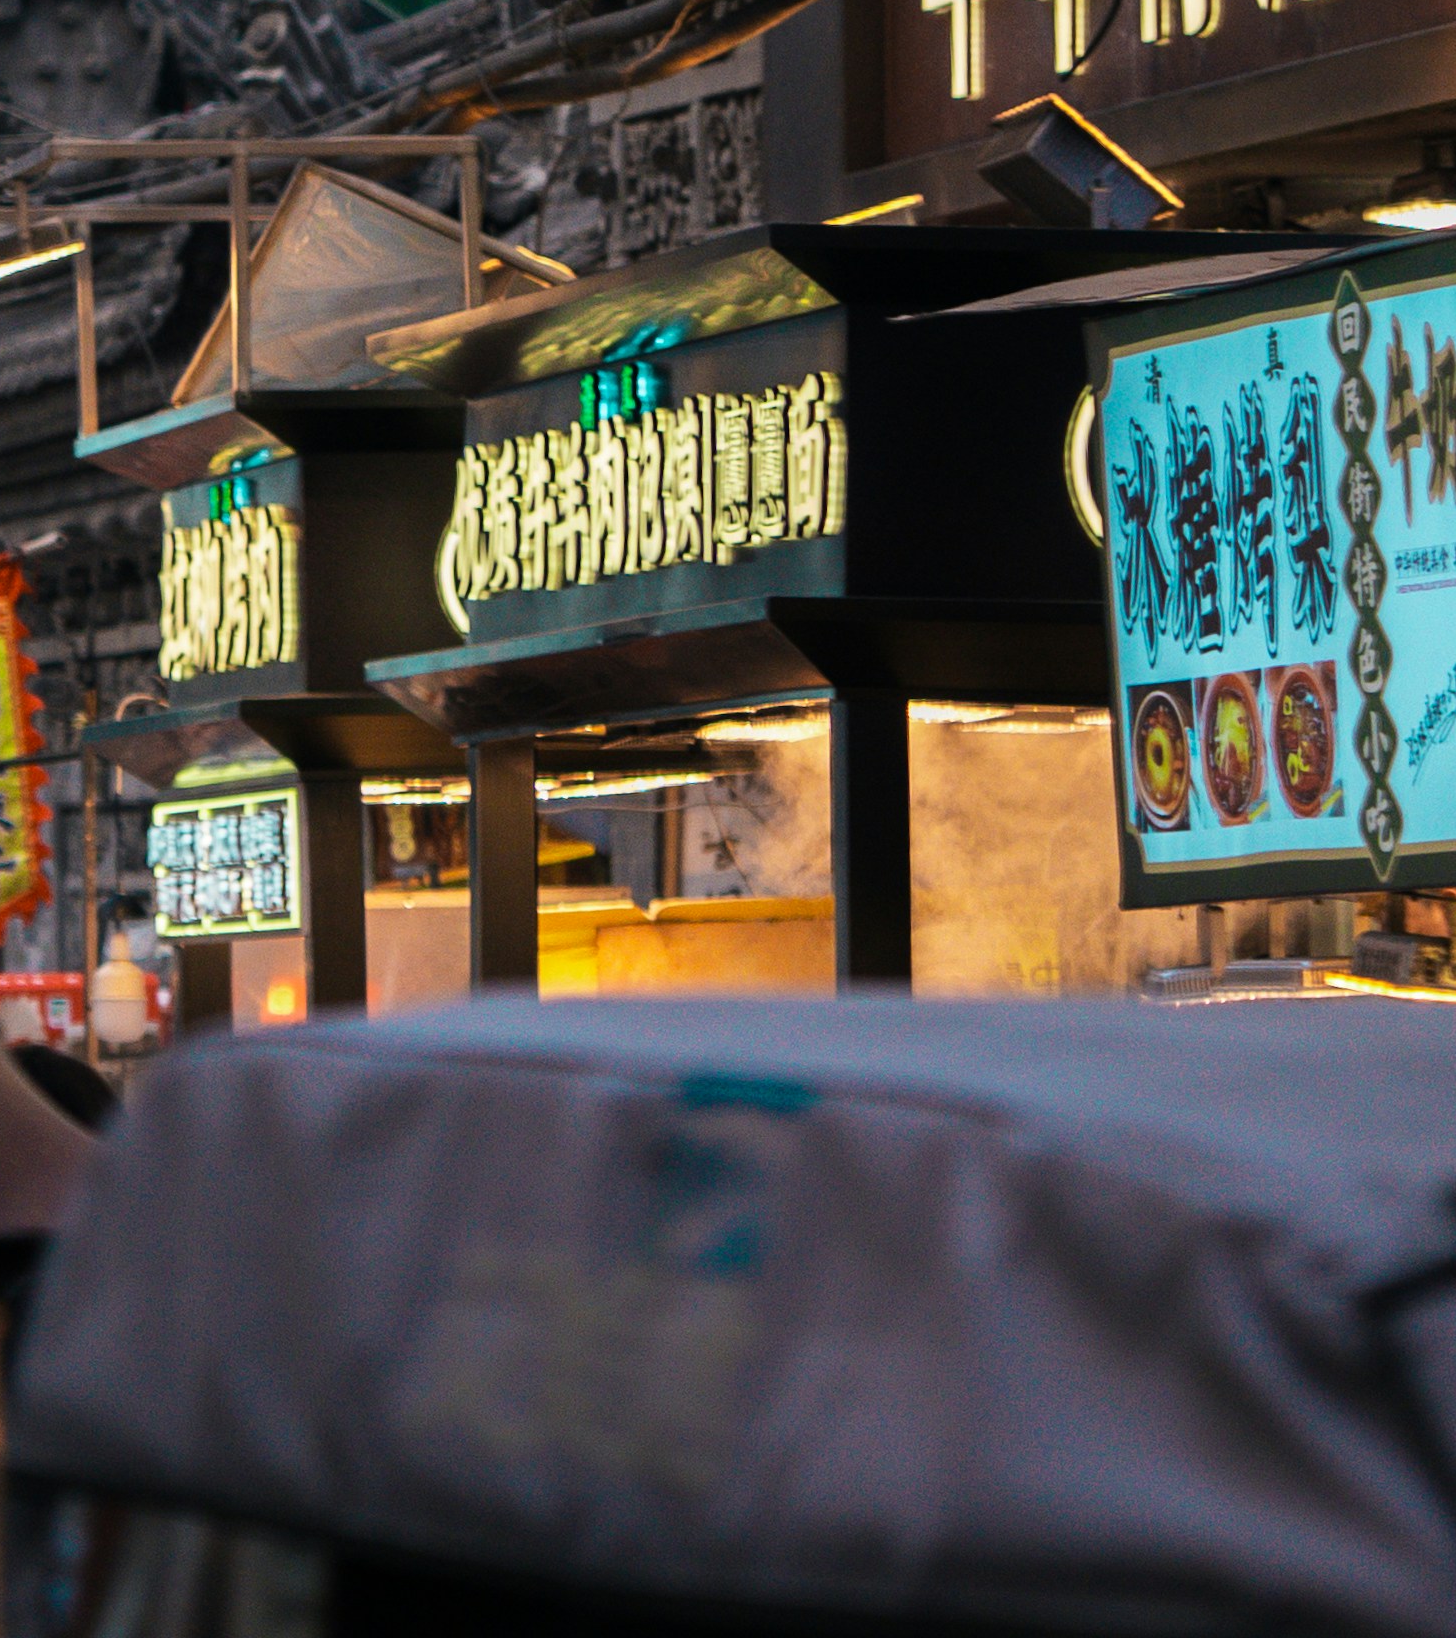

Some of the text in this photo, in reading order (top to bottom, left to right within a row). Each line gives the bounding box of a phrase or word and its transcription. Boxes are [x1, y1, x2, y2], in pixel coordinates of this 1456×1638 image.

[1336, 301, 1396, 854] 回民街特色小吃
